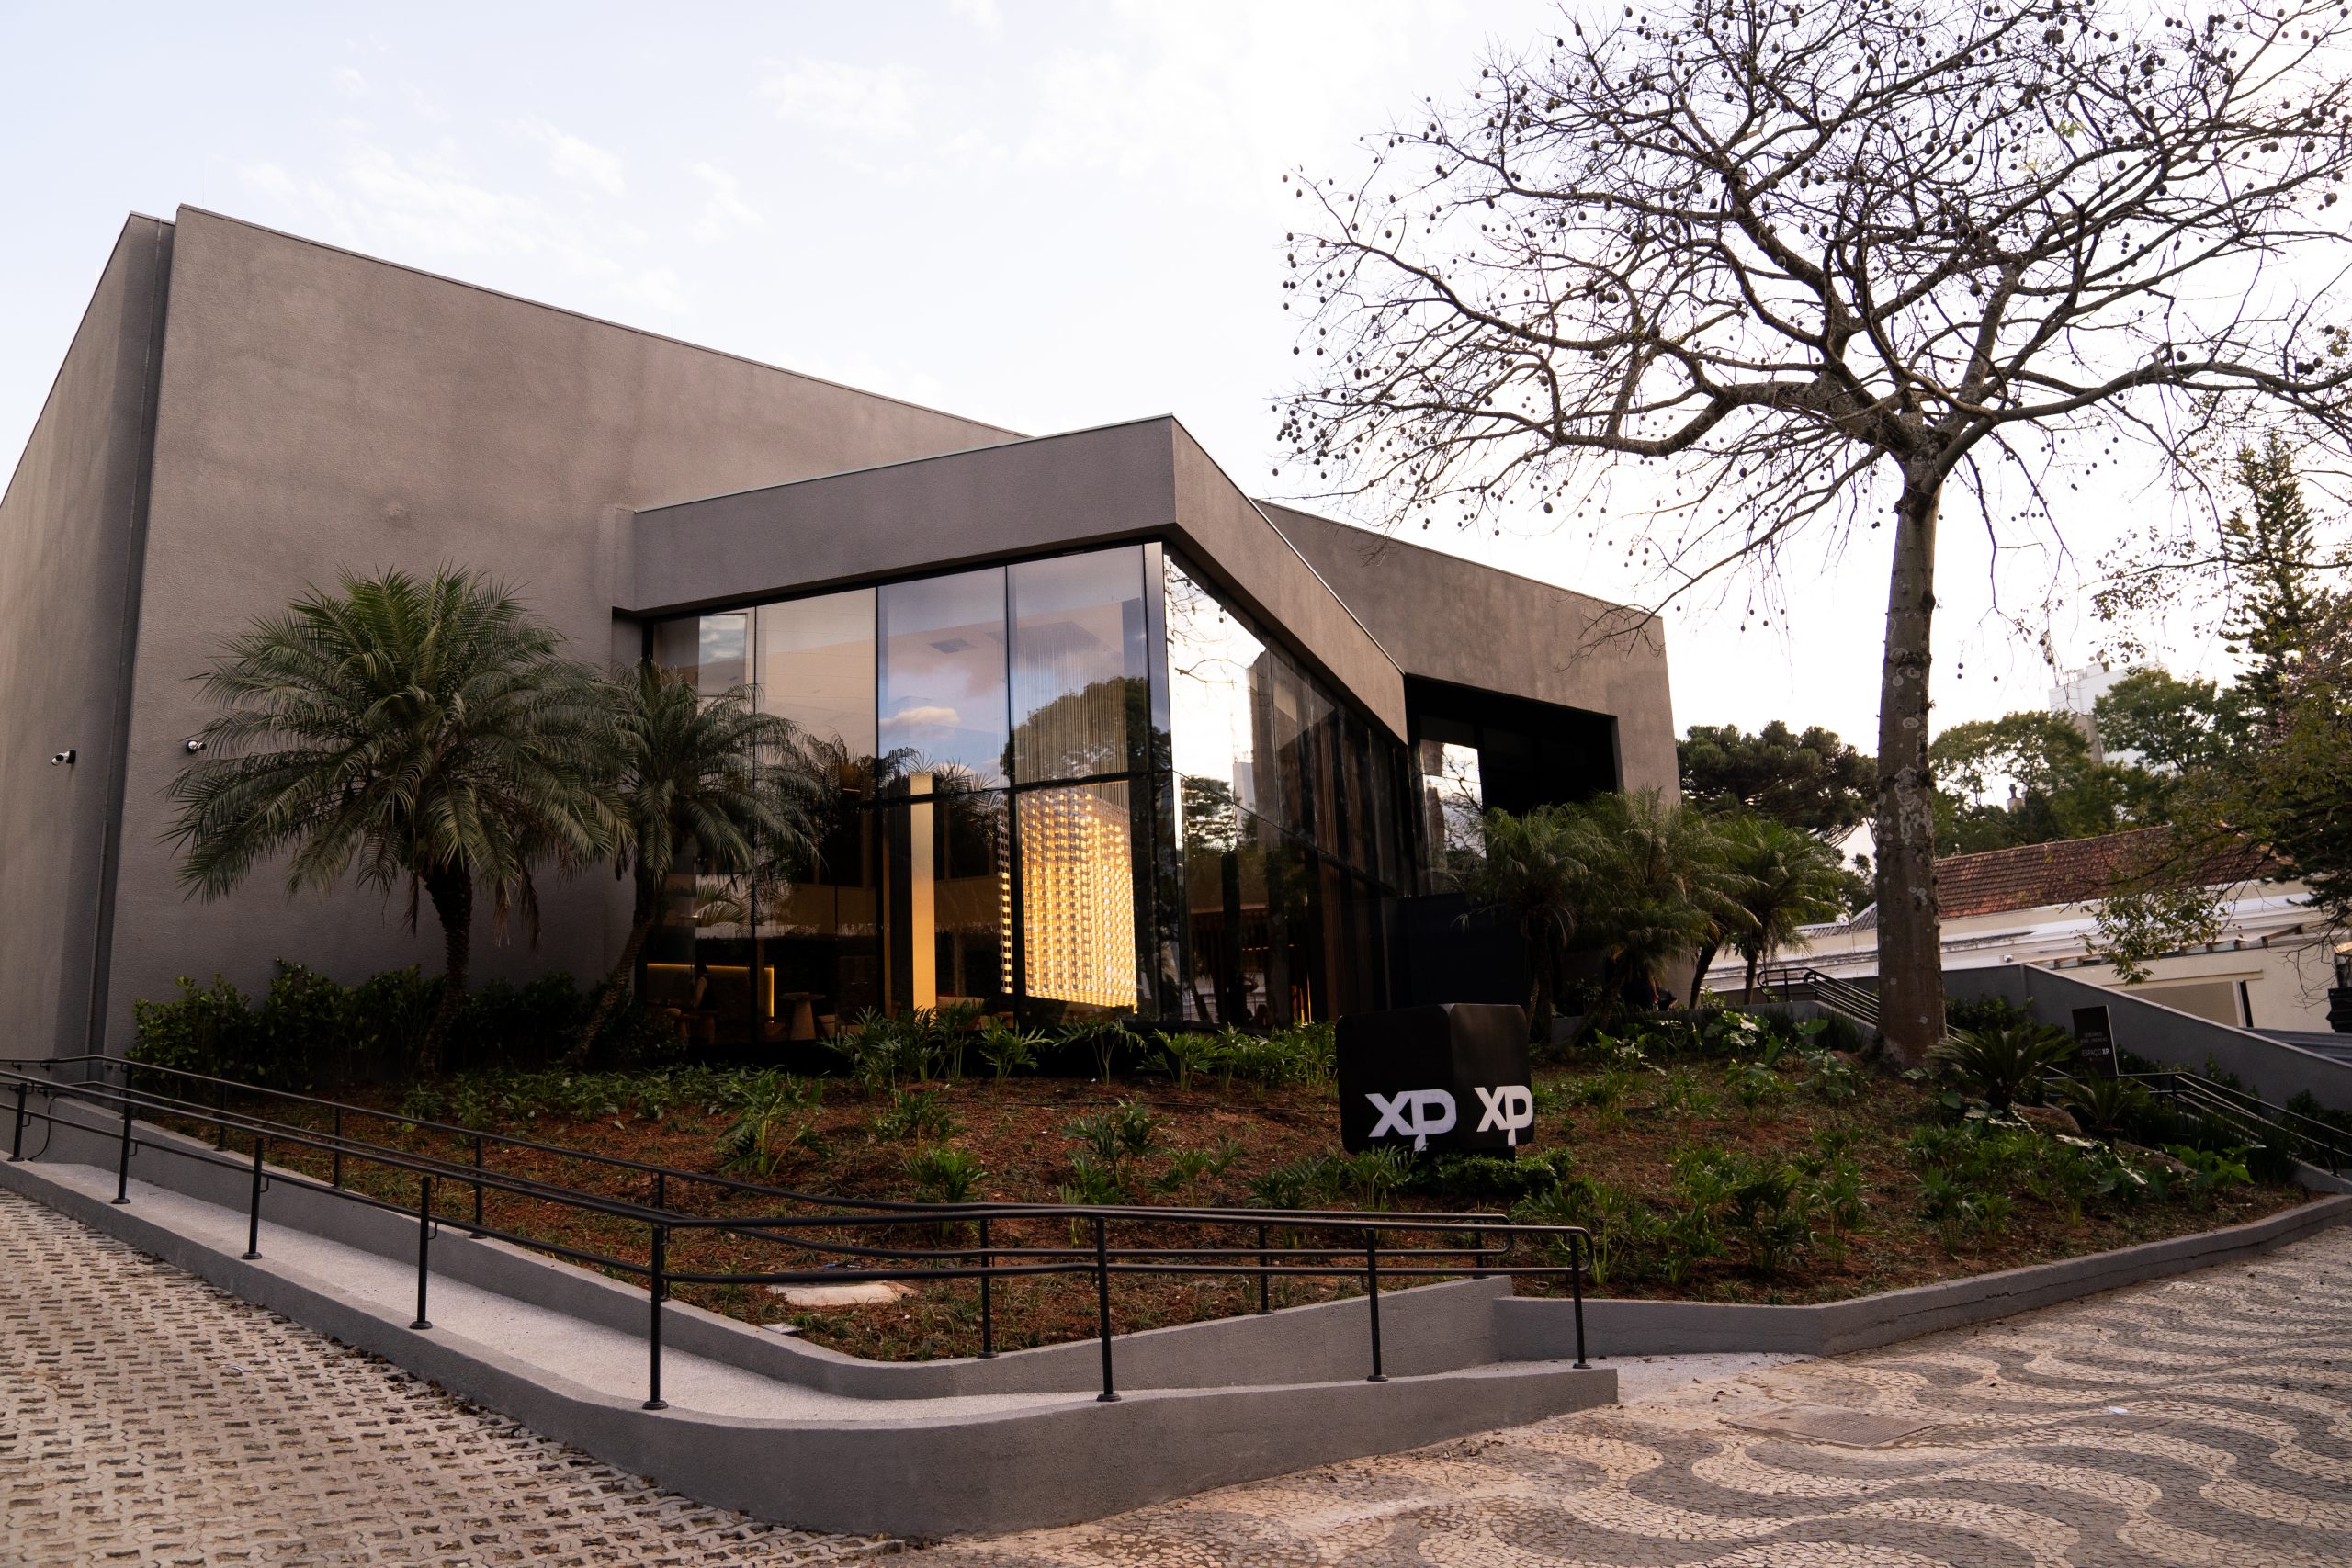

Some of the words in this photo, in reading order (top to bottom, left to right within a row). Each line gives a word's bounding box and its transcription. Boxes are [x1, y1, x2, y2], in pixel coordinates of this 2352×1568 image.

[2102, 1047, 2109, 1055] XP
[1364, 1089, 1457, 1152] XP
[1474, 1085, 1533, 1145] XP
